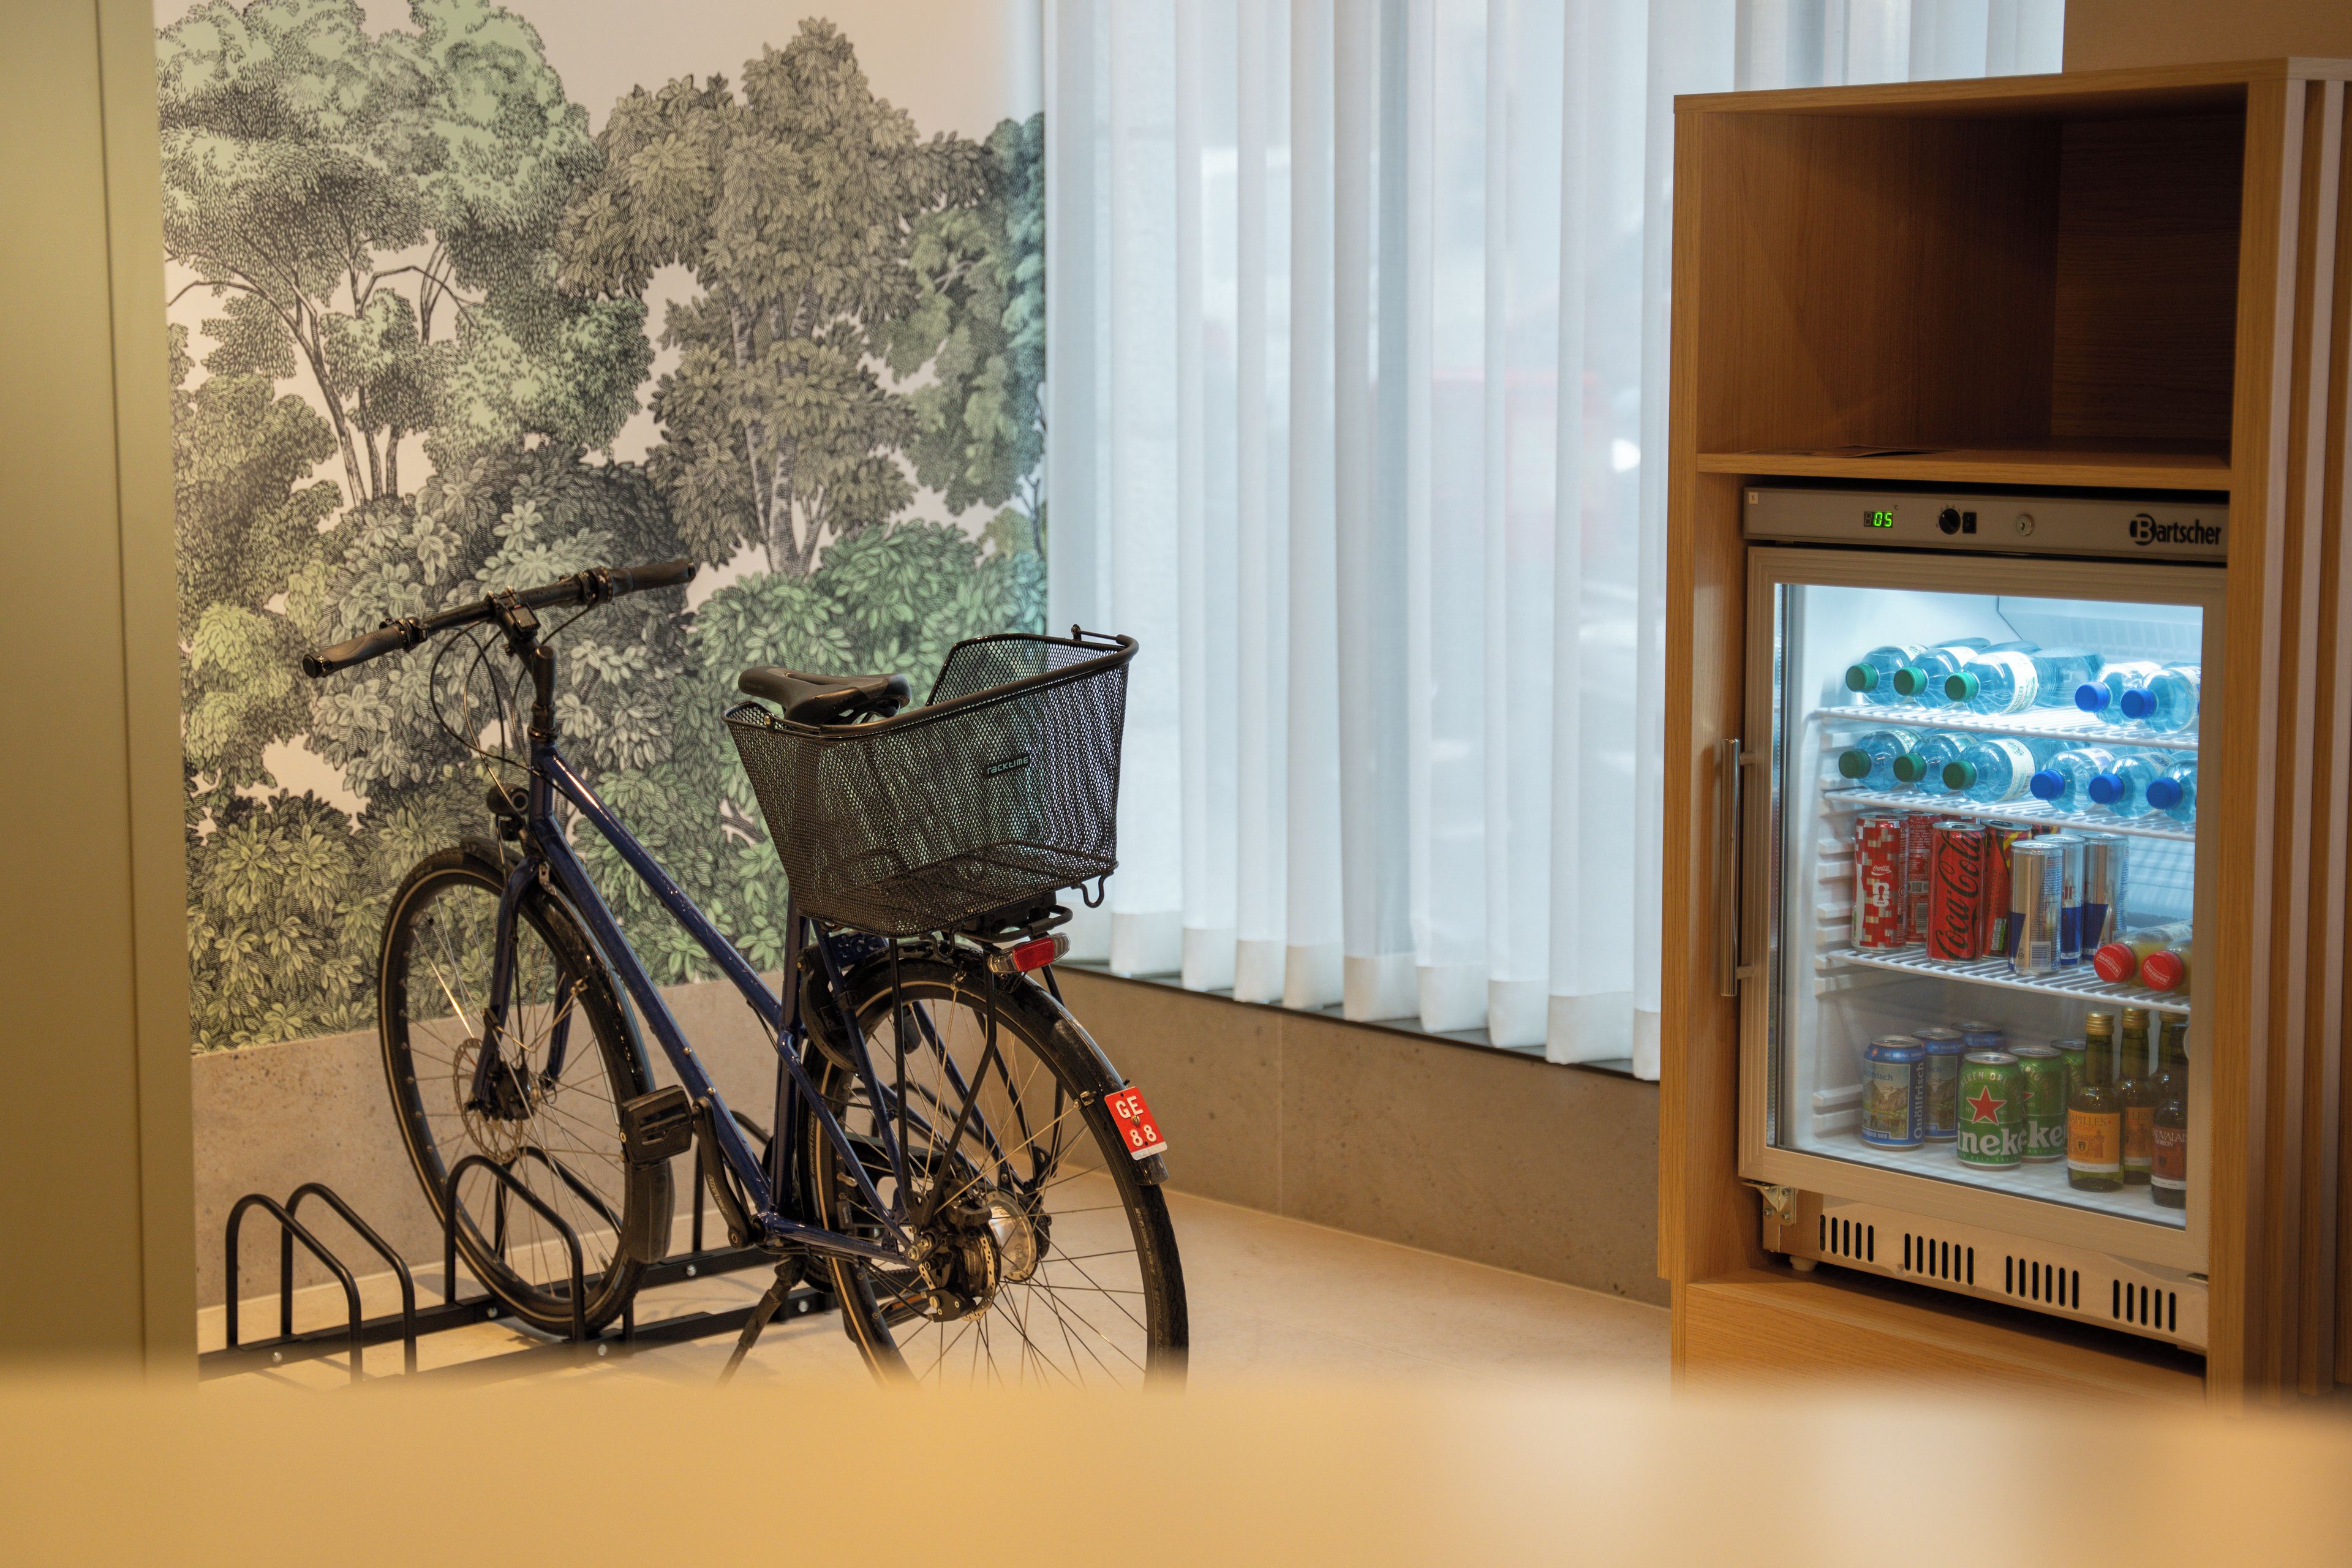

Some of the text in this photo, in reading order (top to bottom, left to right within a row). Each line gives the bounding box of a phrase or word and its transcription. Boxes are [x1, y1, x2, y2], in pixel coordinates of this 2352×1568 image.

[1873, 511, 1893, 527] 05
[2130, 513, 2222, 546] Bartscher
[987, 756, 1028, 775] racktime
[1936, 831, 1980, 960] Coca-Cola
[2098, 955, 2119, 974] RAMSEIER
[1115, 1095, 1144, 1118] GE
[1913, 1062, 1924, 1139] Quöllfrisch
[1130, 1125, 1156, 1147] 88
